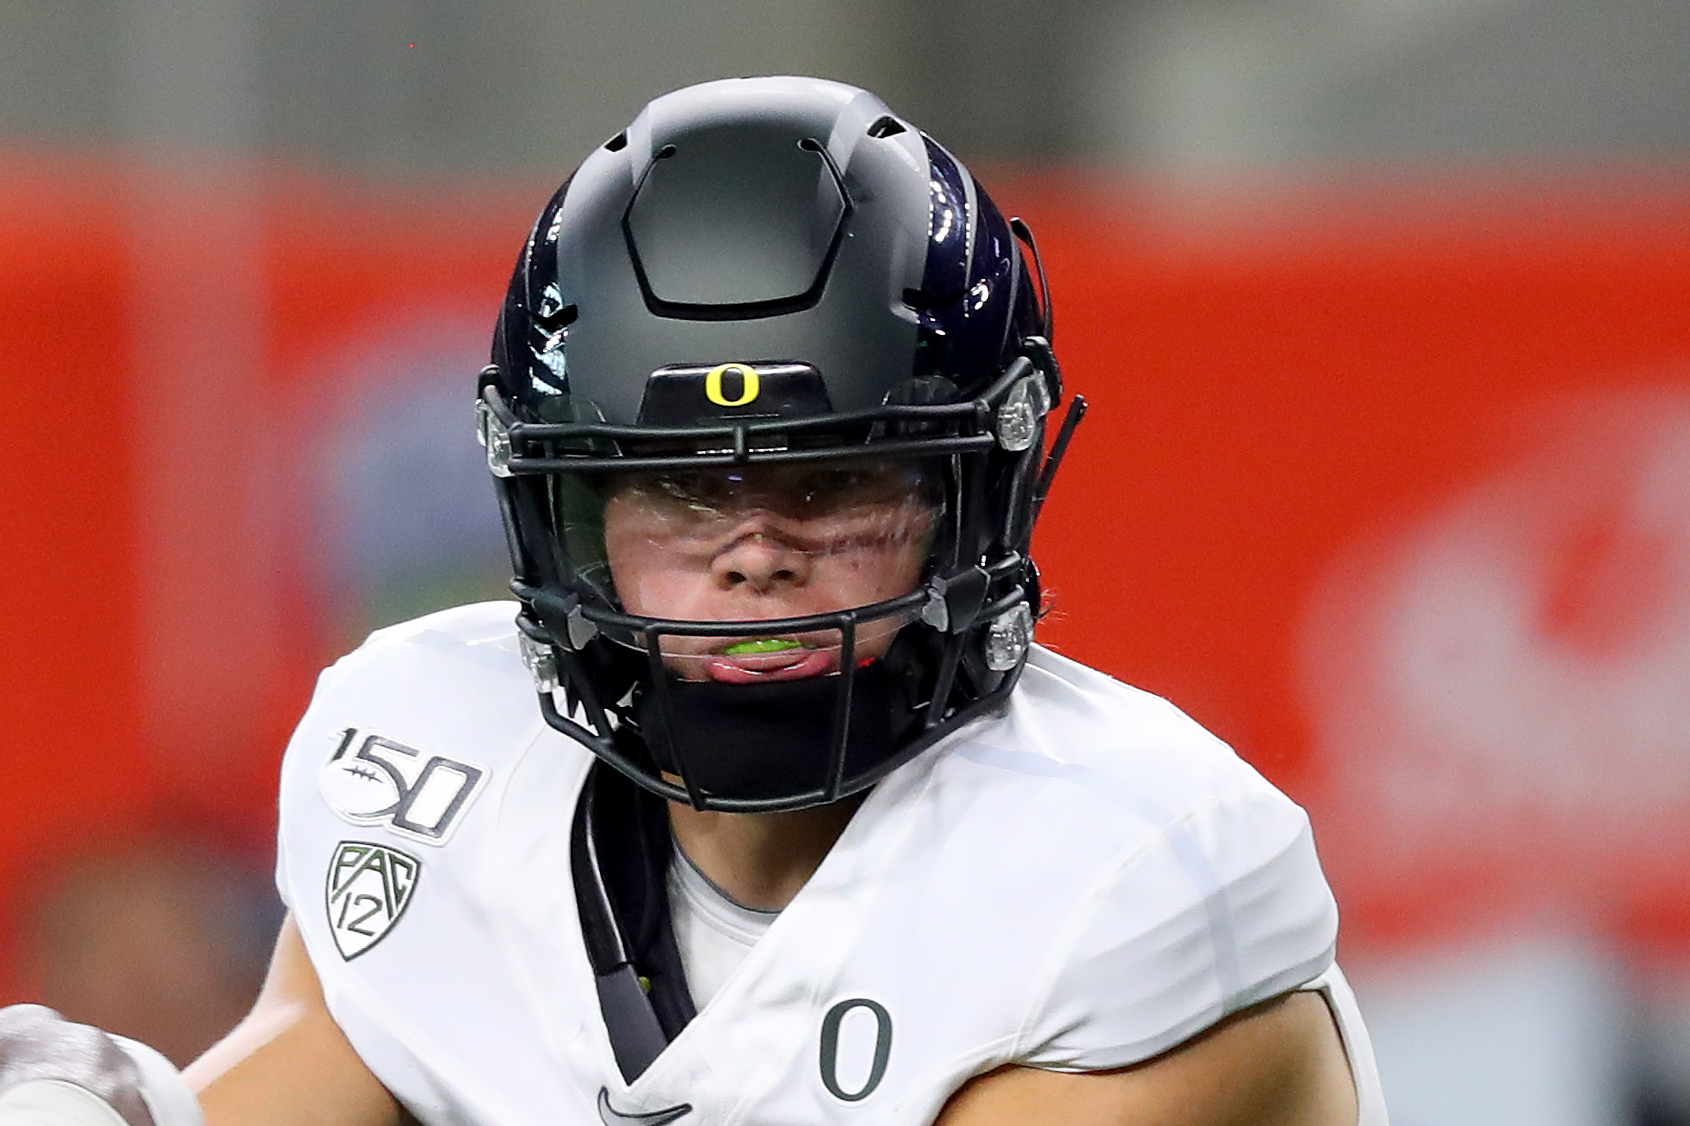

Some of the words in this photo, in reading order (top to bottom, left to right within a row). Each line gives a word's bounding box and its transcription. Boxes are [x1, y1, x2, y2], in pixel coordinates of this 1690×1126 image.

[706, 363, 759, 406] O
[330, 727, 483, 839] 150
[331, 846, 413, 921] PAC
[337, 892, 384, 937] 12
